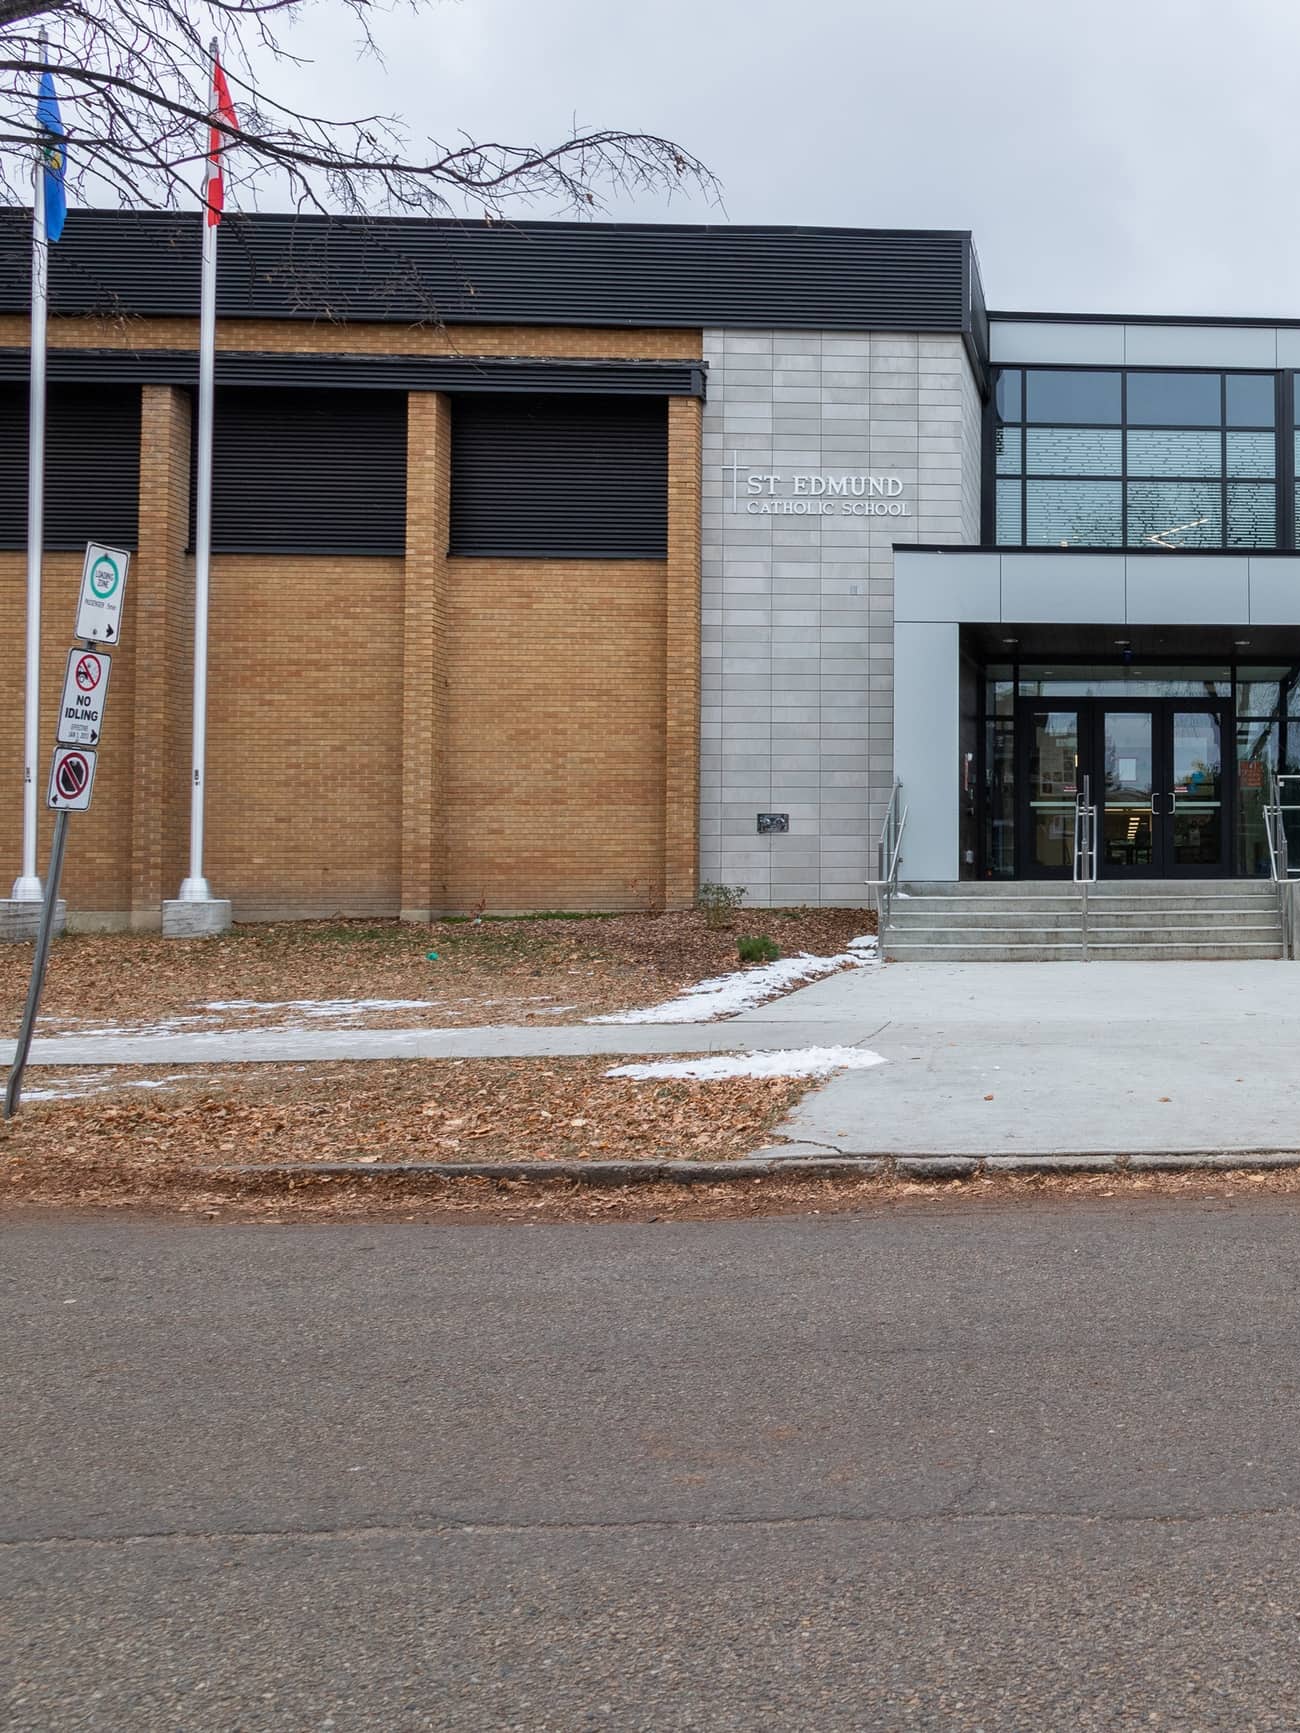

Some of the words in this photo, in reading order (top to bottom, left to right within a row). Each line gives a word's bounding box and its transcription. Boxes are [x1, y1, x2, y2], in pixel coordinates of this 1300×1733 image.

[747, 475, 781, 496] ST
[792, 475, 904, 497] EDMUND
[746, 501, 835, 516] CATHOLIC
[841, 502, 912, 517] SCHOOL
[76, 695, 92, 707] NO
[64, 708, 98, 722] IDLING
